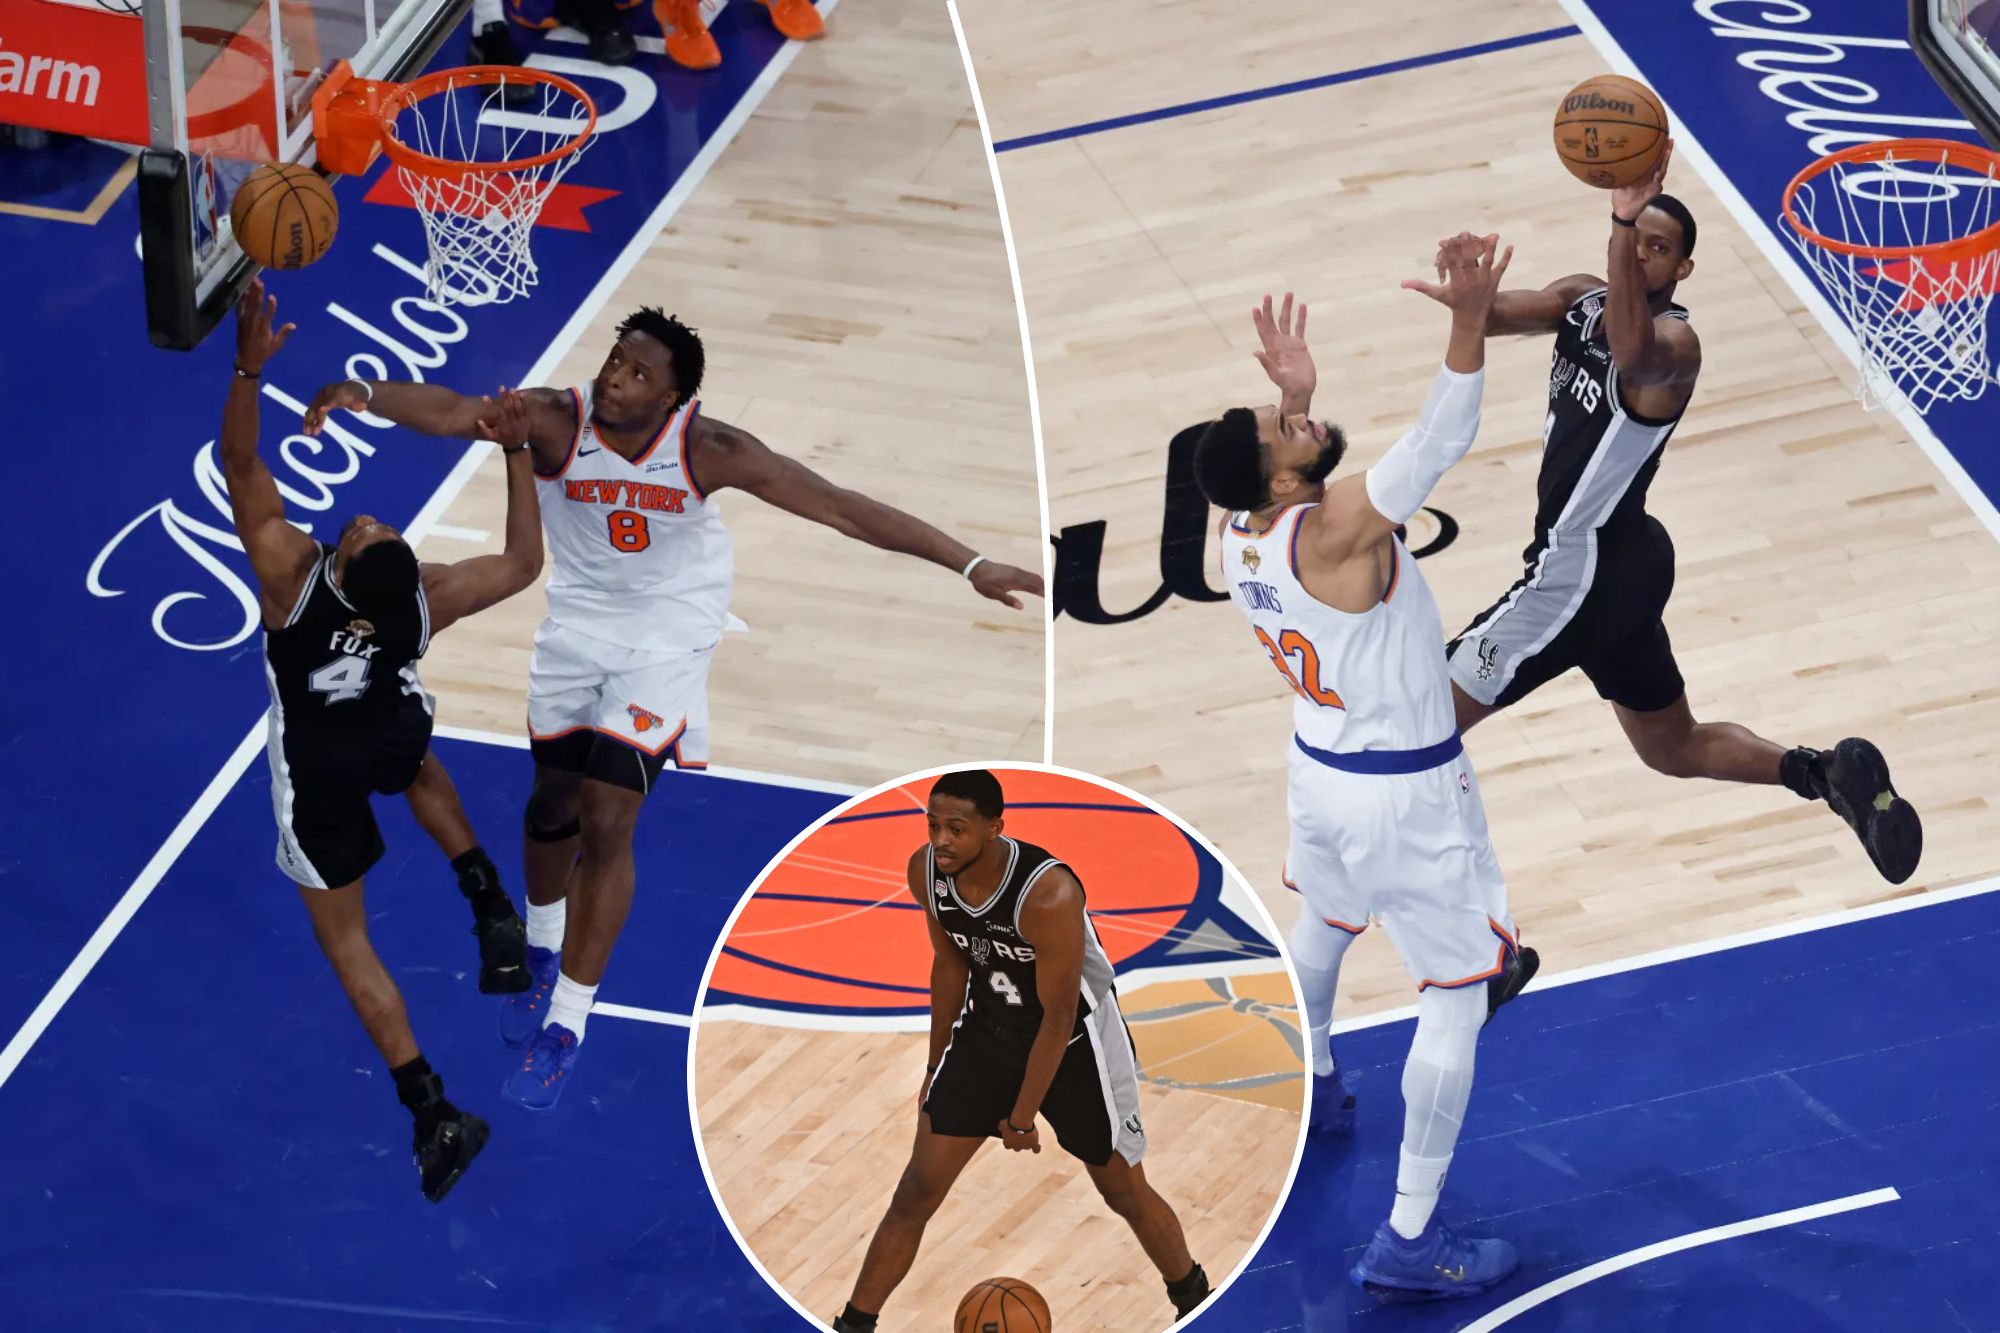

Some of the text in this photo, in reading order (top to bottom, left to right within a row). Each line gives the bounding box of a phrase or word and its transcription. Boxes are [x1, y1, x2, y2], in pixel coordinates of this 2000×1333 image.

[0, 38, 100, 106] arm
[1564, 92, 1634, 115] Wilson
[565, 479, 688, 513] NEW YORK
[607, 509, 650, 552] 8
[1238, 580, 1282, 614] TOWNS
[329, 631, 381, 659] FOX
[309, 655, 371, 706] 4
[1253, 624, 1346, 711] 32
[989, 971, 1023, 1006] 4
